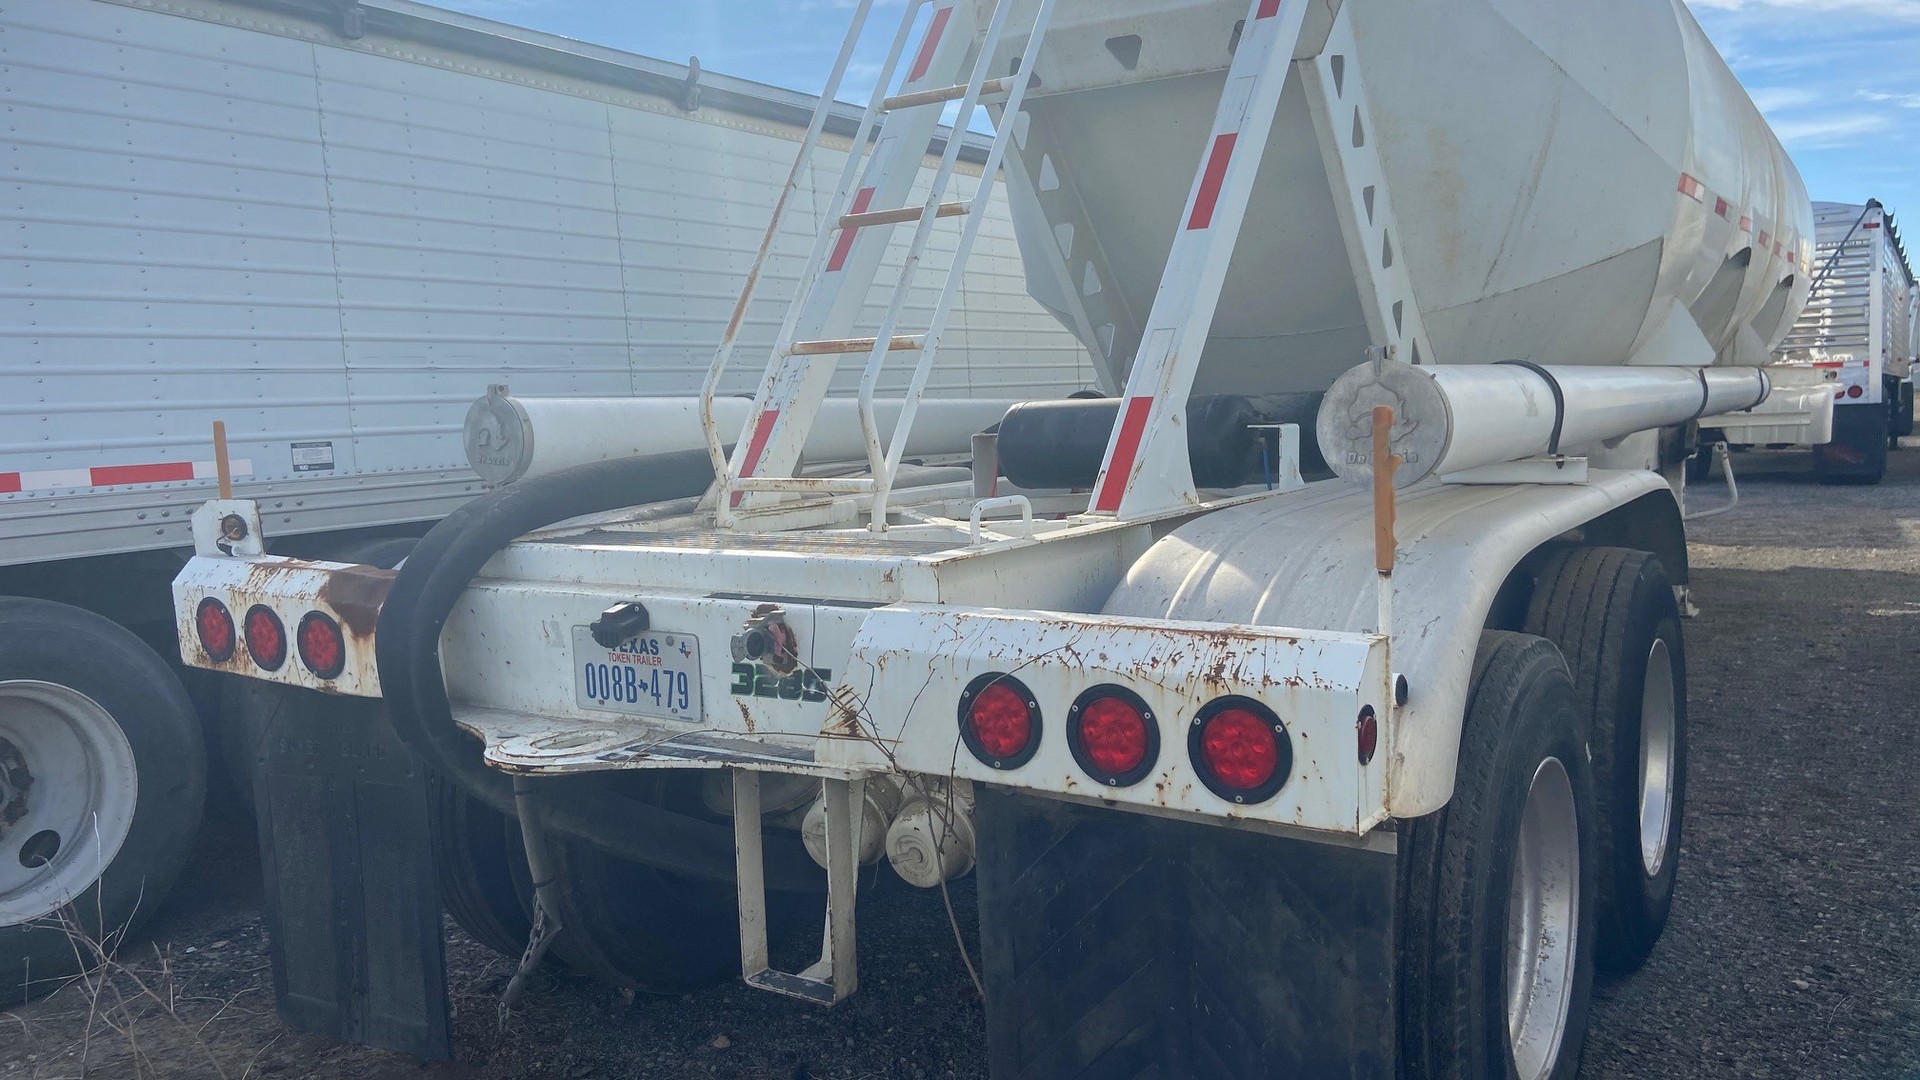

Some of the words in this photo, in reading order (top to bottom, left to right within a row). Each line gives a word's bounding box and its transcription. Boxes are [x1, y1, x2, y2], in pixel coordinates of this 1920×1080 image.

[612, 637, 659, 656] EXAS
[608, 652, 631, 664] TOKEN
[632, 654, 663, 667] TRAILER
